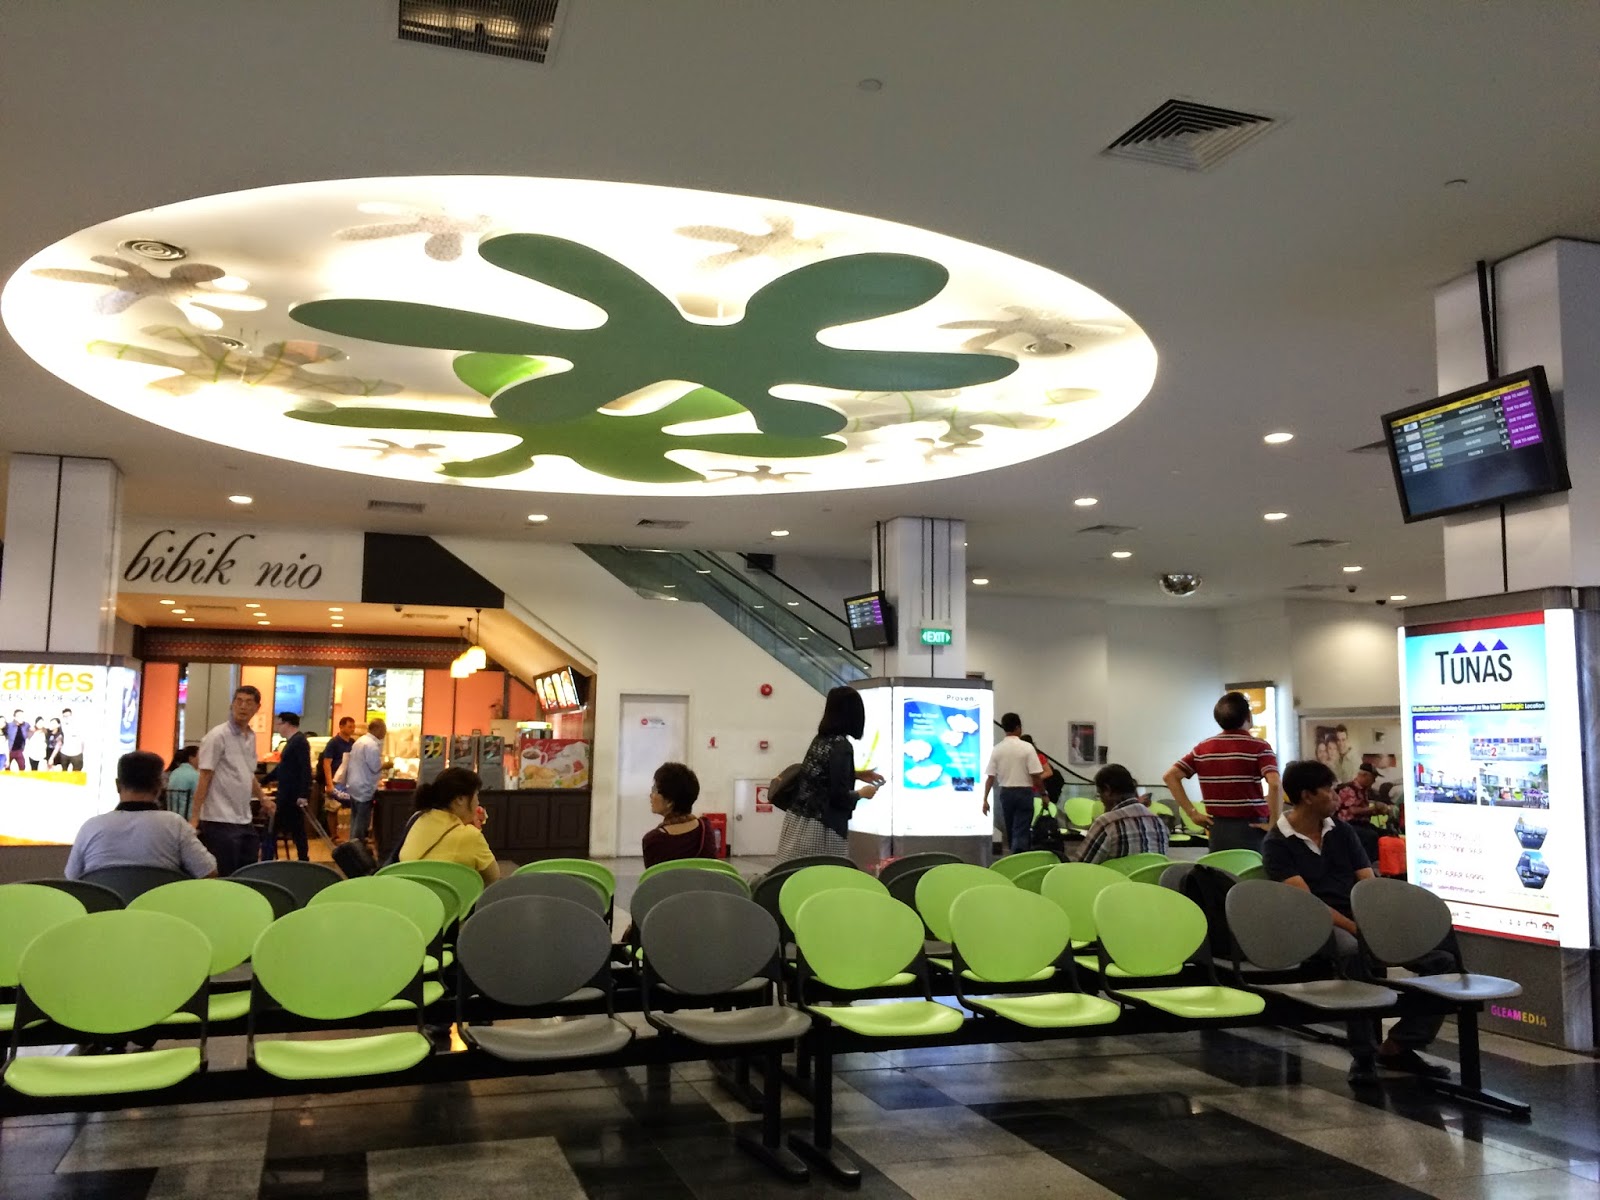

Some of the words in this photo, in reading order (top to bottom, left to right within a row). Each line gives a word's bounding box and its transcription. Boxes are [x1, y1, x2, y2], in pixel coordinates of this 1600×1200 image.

[124, 530, 255, 585] bibik
[255, 553, 322, 590] nio
[927, 631, 946, 642] EXIT
[1435, 650, 1512, 685] TUNAS
[1491, 1004, 1547, 1027] GLEAMEDIA
